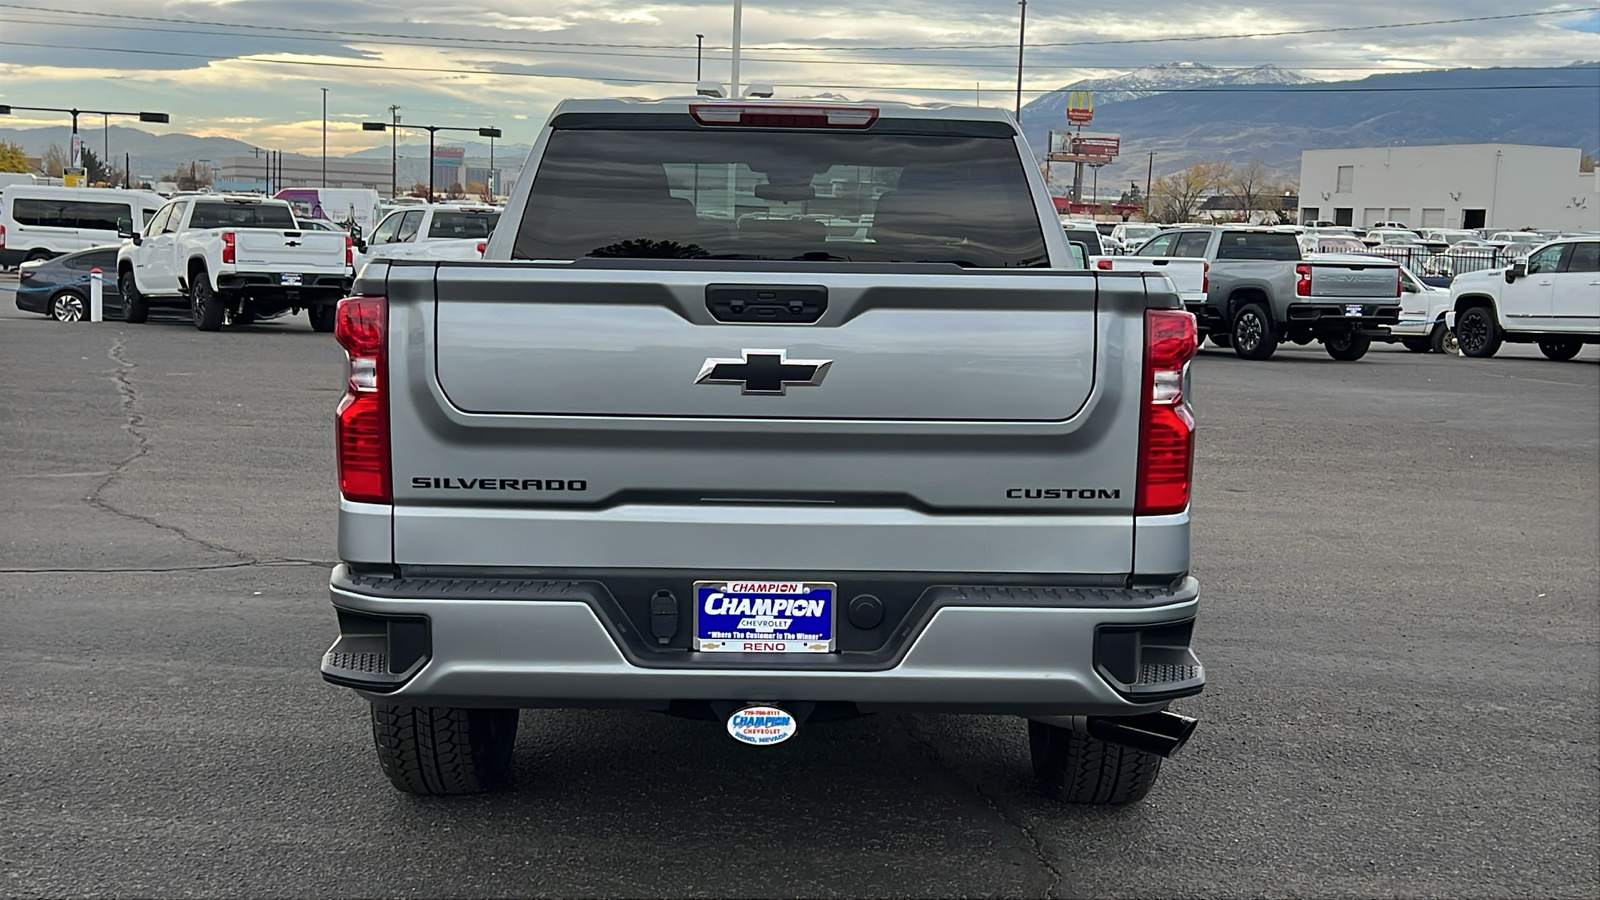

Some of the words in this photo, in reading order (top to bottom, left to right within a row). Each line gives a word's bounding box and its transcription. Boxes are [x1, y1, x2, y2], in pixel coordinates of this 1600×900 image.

[1319, 274, 1395, 283] CHEVROLET
[412, 477, 587, 491] SILVERADO
[1006, 488, 1121, 499] CUSTOM
[732, 583, 798, 593] CHAMPION
[704, 592, 826, 617] CHAMPION
[741, 619, 788, 628] CHEVROLET
[733, 631, 745, 639] The
[745, 631, 776, 640] Customer
[784, 632, 795, 640] The
[743, 642, 787, 652] RENO
[732, 714, 791, 728] CHAMPION
[734, 731, 758, 743] RENO,
[758, 731, 789, 743] NEVADA
